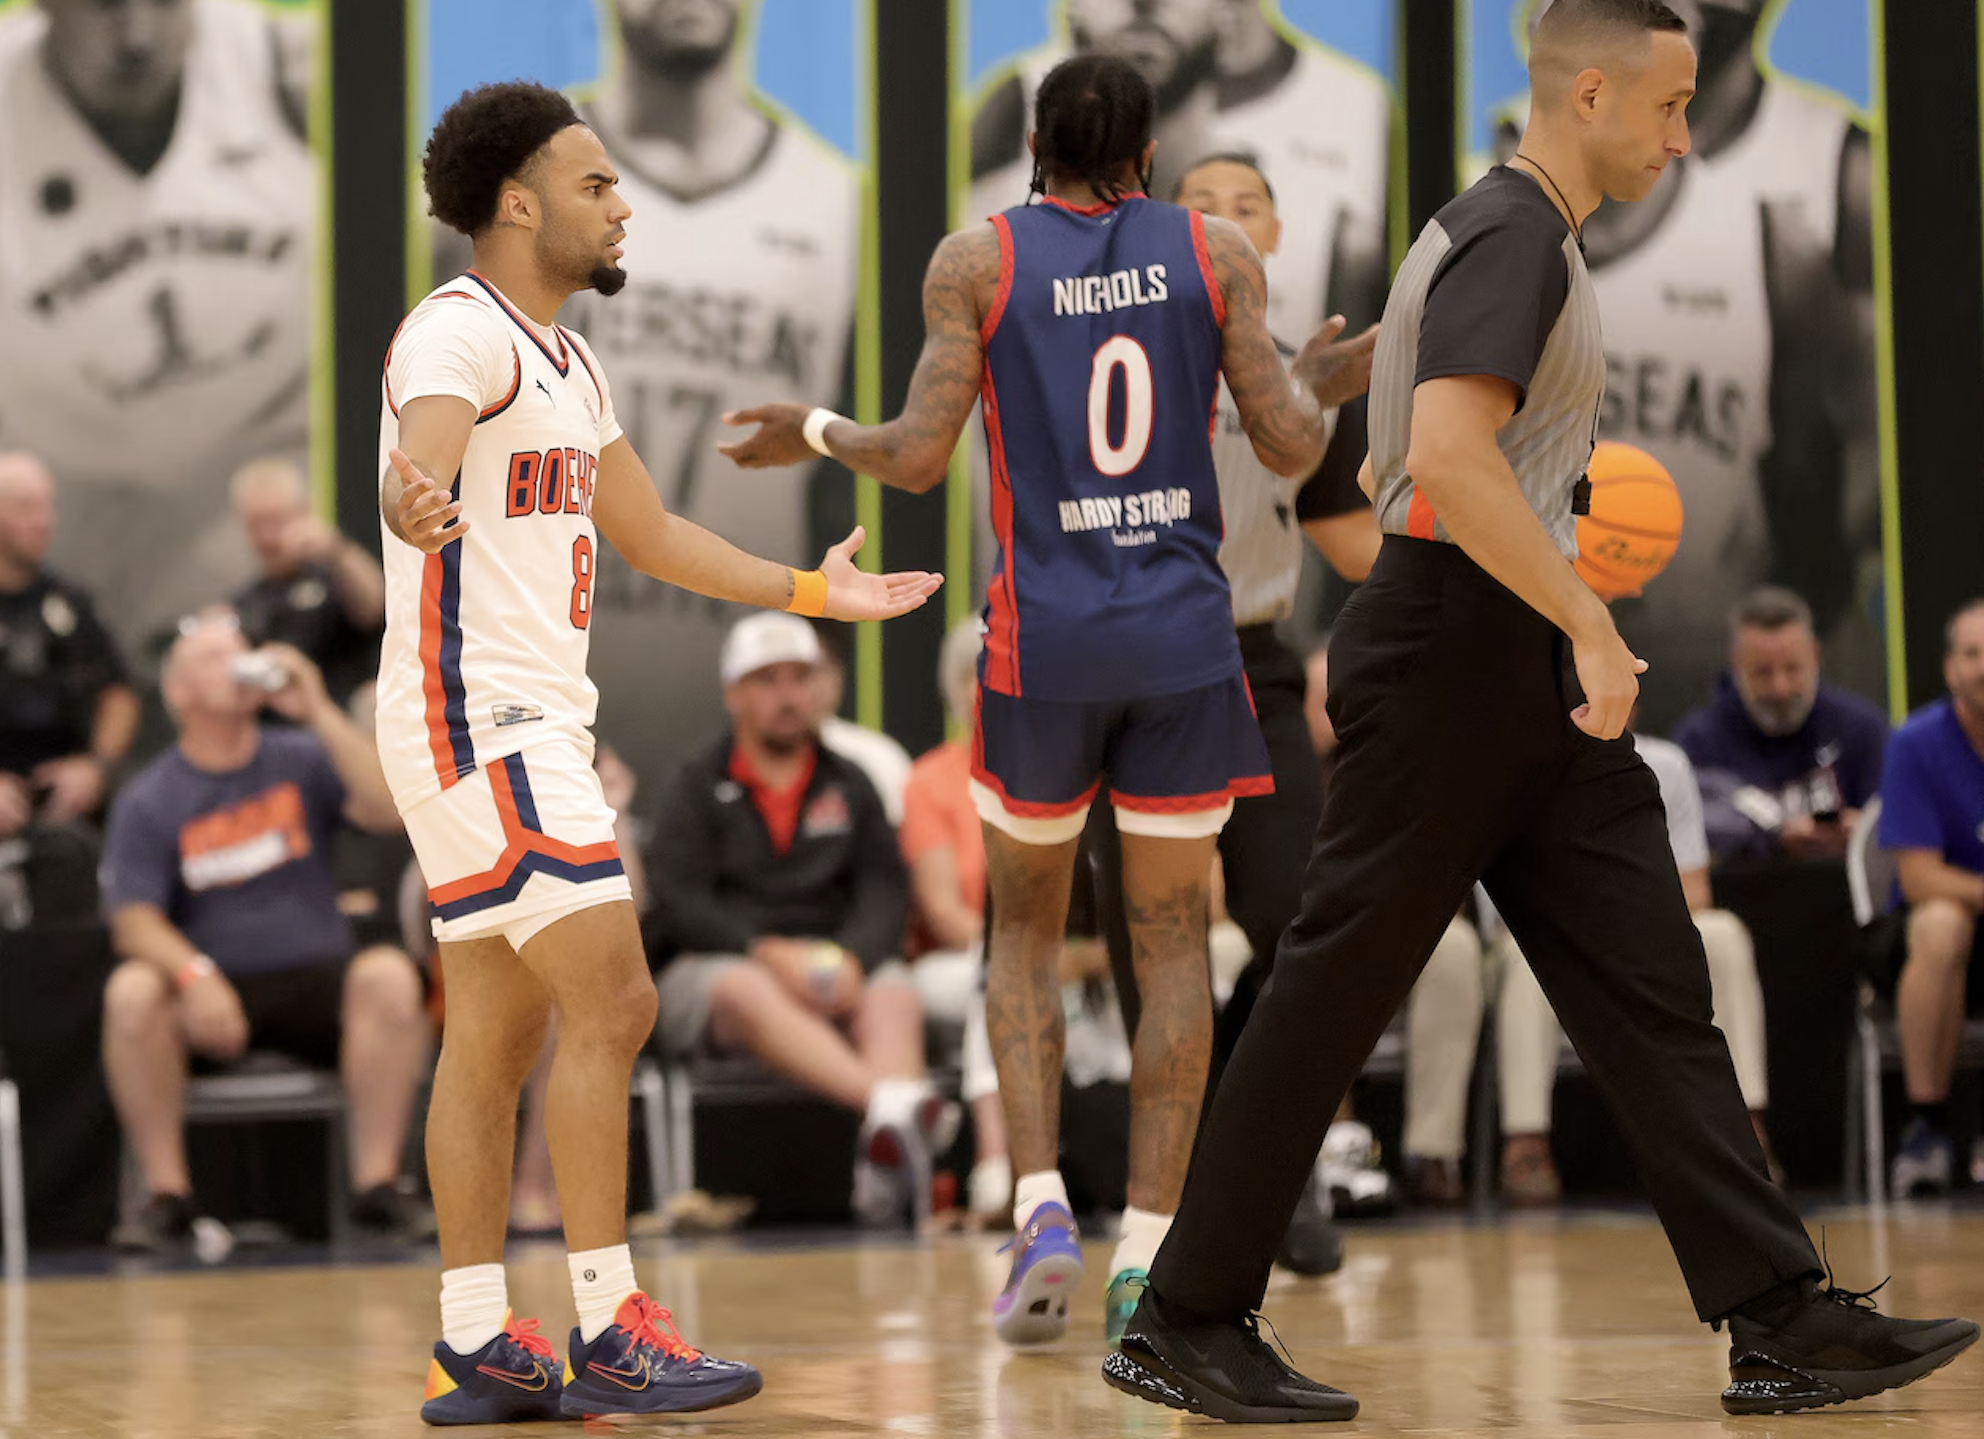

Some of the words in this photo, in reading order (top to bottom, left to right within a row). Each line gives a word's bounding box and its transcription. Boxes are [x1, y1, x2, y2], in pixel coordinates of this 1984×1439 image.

[1053, 263, 1168, 316] NICHOLS
[1087, 333, 1156, 478] 0
[505, 447, 599, 518] BOEHE
[1058, 497, 1122, 533] HARDY
[569, 534, 594, 631] 8
